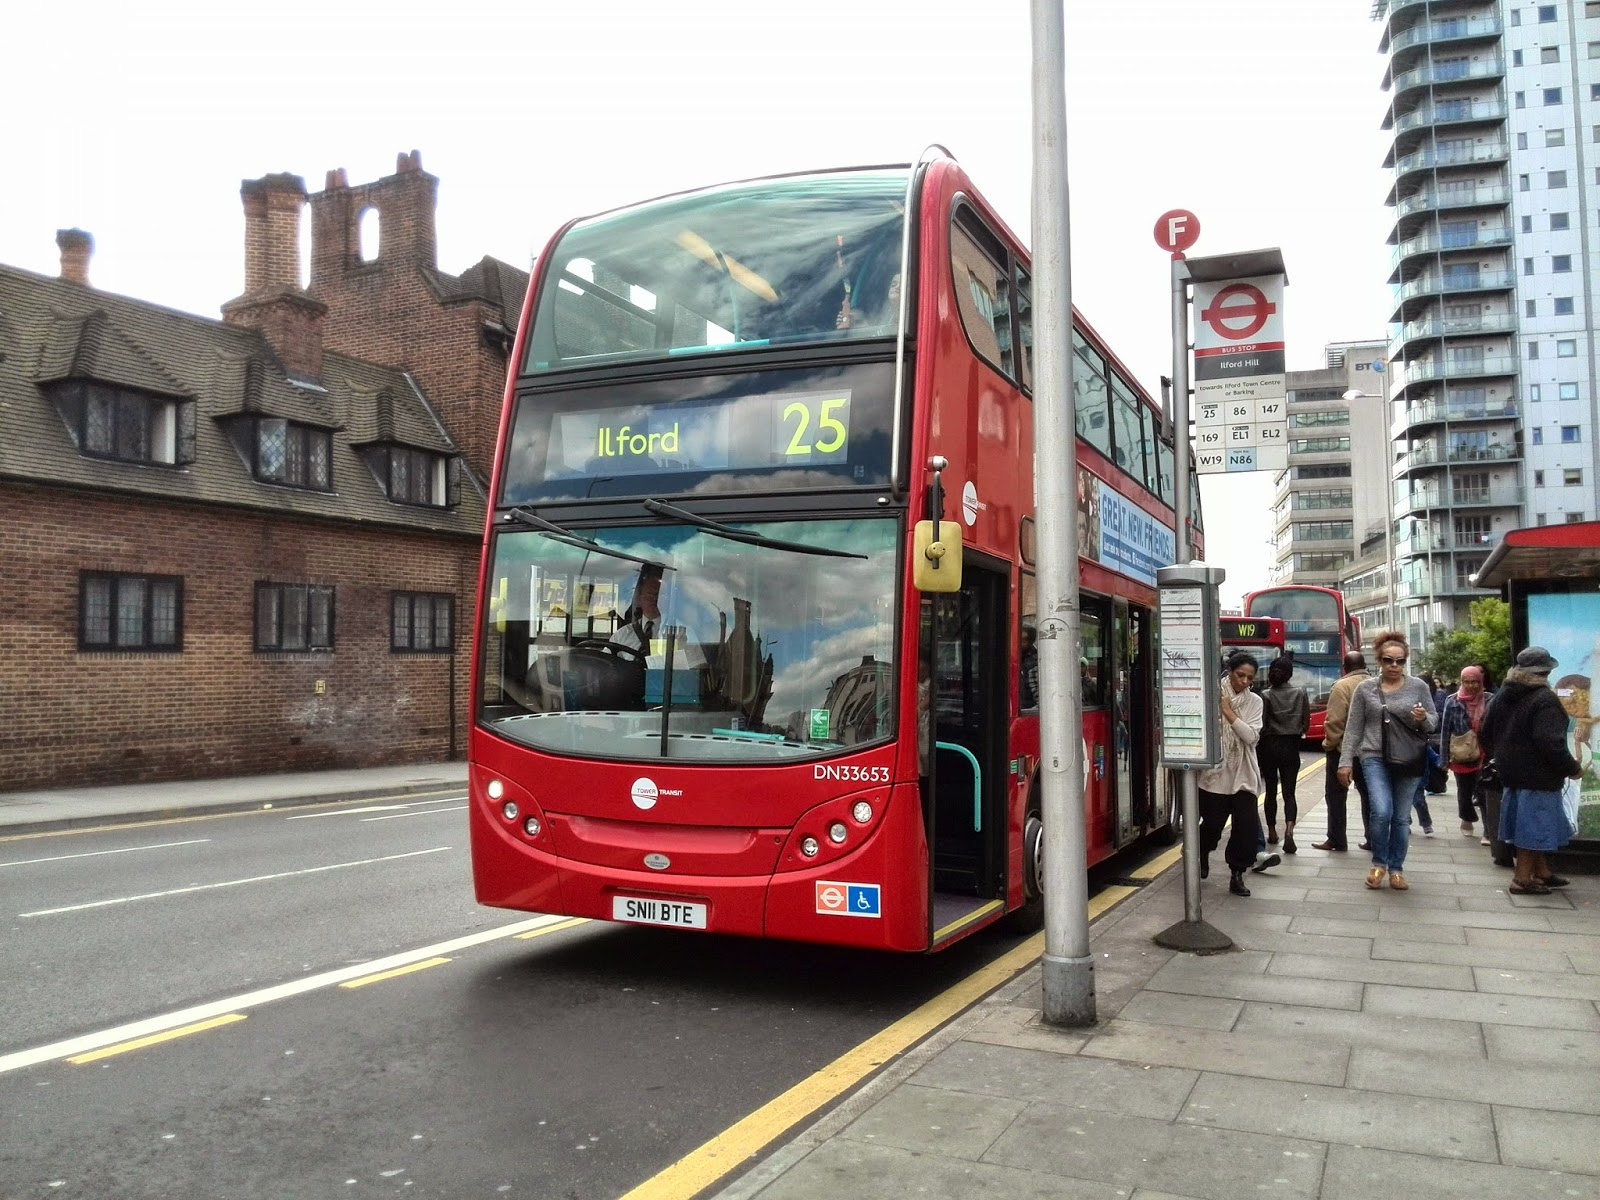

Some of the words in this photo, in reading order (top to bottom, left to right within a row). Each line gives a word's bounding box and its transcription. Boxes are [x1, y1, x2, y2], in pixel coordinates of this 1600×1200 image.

[1168, 216, 1188, 246] F
[1220, 360, 1242, 369] Ilford
[1245, 359, 1260, 367] Hill
[1355, 363, 1372, 371] BT
[1233, 406, 1247, 416] 86
[1262, 404, 1279, 414] 147
[1203, 410, 1216, 419] 25
[598, 422, 679, 457] Ilford
[783, 398, 847, 456] 25
[1201, 433, 1219, 443] 169
[1232, 431, 1249, 440] EL1
[1262, 429, 1281, 438] EL2
[1200, 455, 1222, 465] W19
[1230, 455, 1252, 465] N86
[1238, 624, 1256, 637] W19
[1308, 641, 1326, 653] EL2
[814, 764, 890, 782] DN33653
[659, 789, 683, 797] TRANSIT
[626, 900, 656, 920] SN11
[660, 903, 693, 924] BTE
